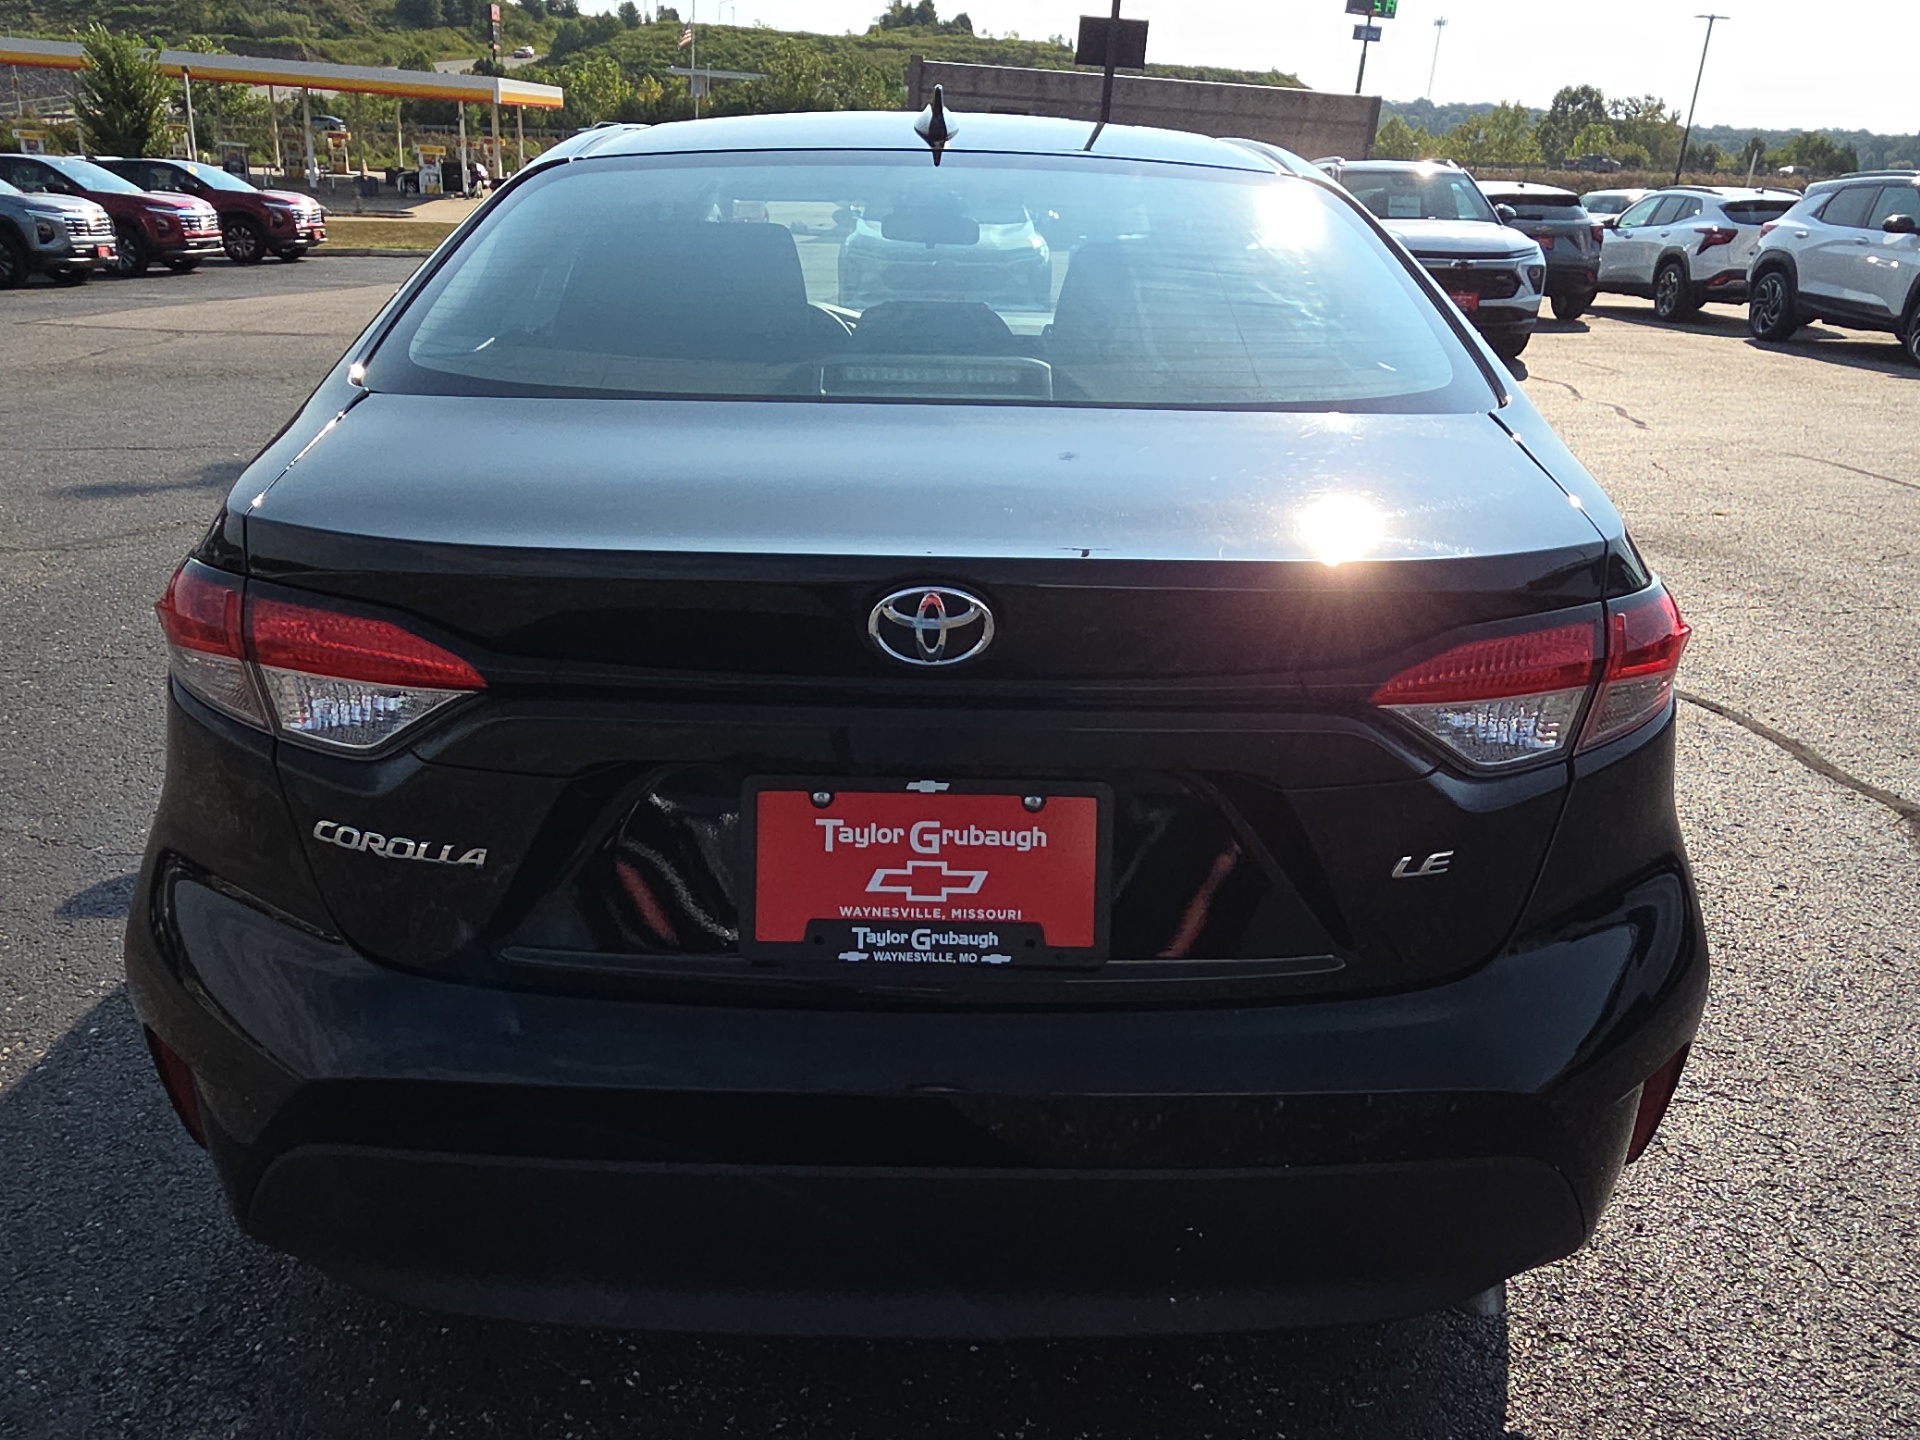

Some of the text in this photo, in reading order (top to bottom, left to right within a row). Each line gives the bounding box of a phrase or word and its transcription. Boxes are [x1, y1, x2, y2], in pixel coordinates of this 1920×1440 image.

[313, 820, 488, 868] COROLLA
[815, 818, 1047, 854] Taylor Grubaugh
[1392, 850, 1454, 878] LE
[839, 906, 1022, 920] WAYNESVILLE, MISSOURI
[851, 926, 999, 950] Taylor Grubaugh
[873, 951, 978, 963] WAYNESVILLE, MO
